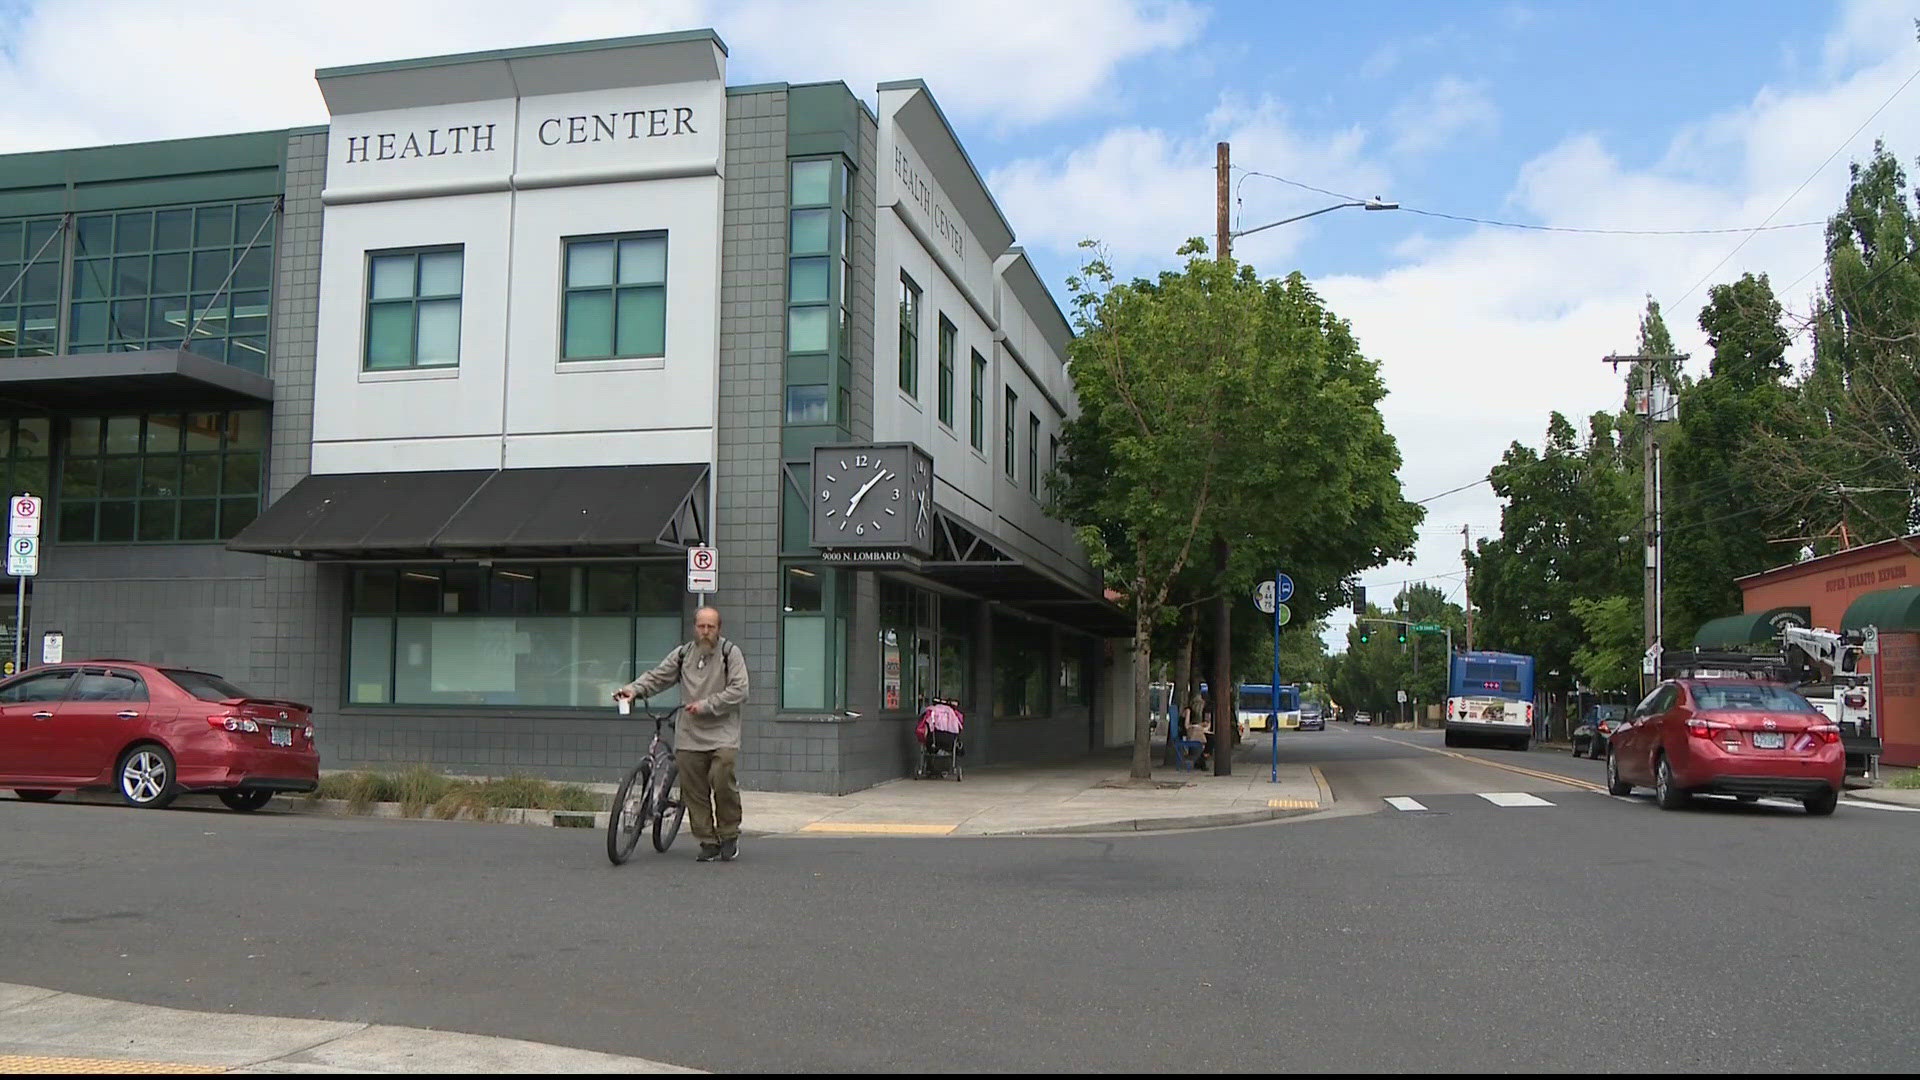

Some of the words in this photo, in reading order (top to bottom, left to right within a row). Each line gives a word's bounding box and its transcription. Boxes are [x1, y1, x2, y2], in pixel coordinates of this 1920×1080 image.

[346, 123, 496, 164] HEALTH
[538, 107, 698, 146] CENTER
[894, 145, 931, 217] HEALTH
[935, 204, 964, 261] CENTER
[855, 455, 868, 467] 12
[822, 490, 830, 501] 9
[891, 489, 900, 500] 3
[856, 523, 864, 535] 6
[20, 541, 29, 551] P
[822, 552, 841, 560] 9000
[843, 552, 851, 560] N
[853, 552, 900, 560] LOMBARD
